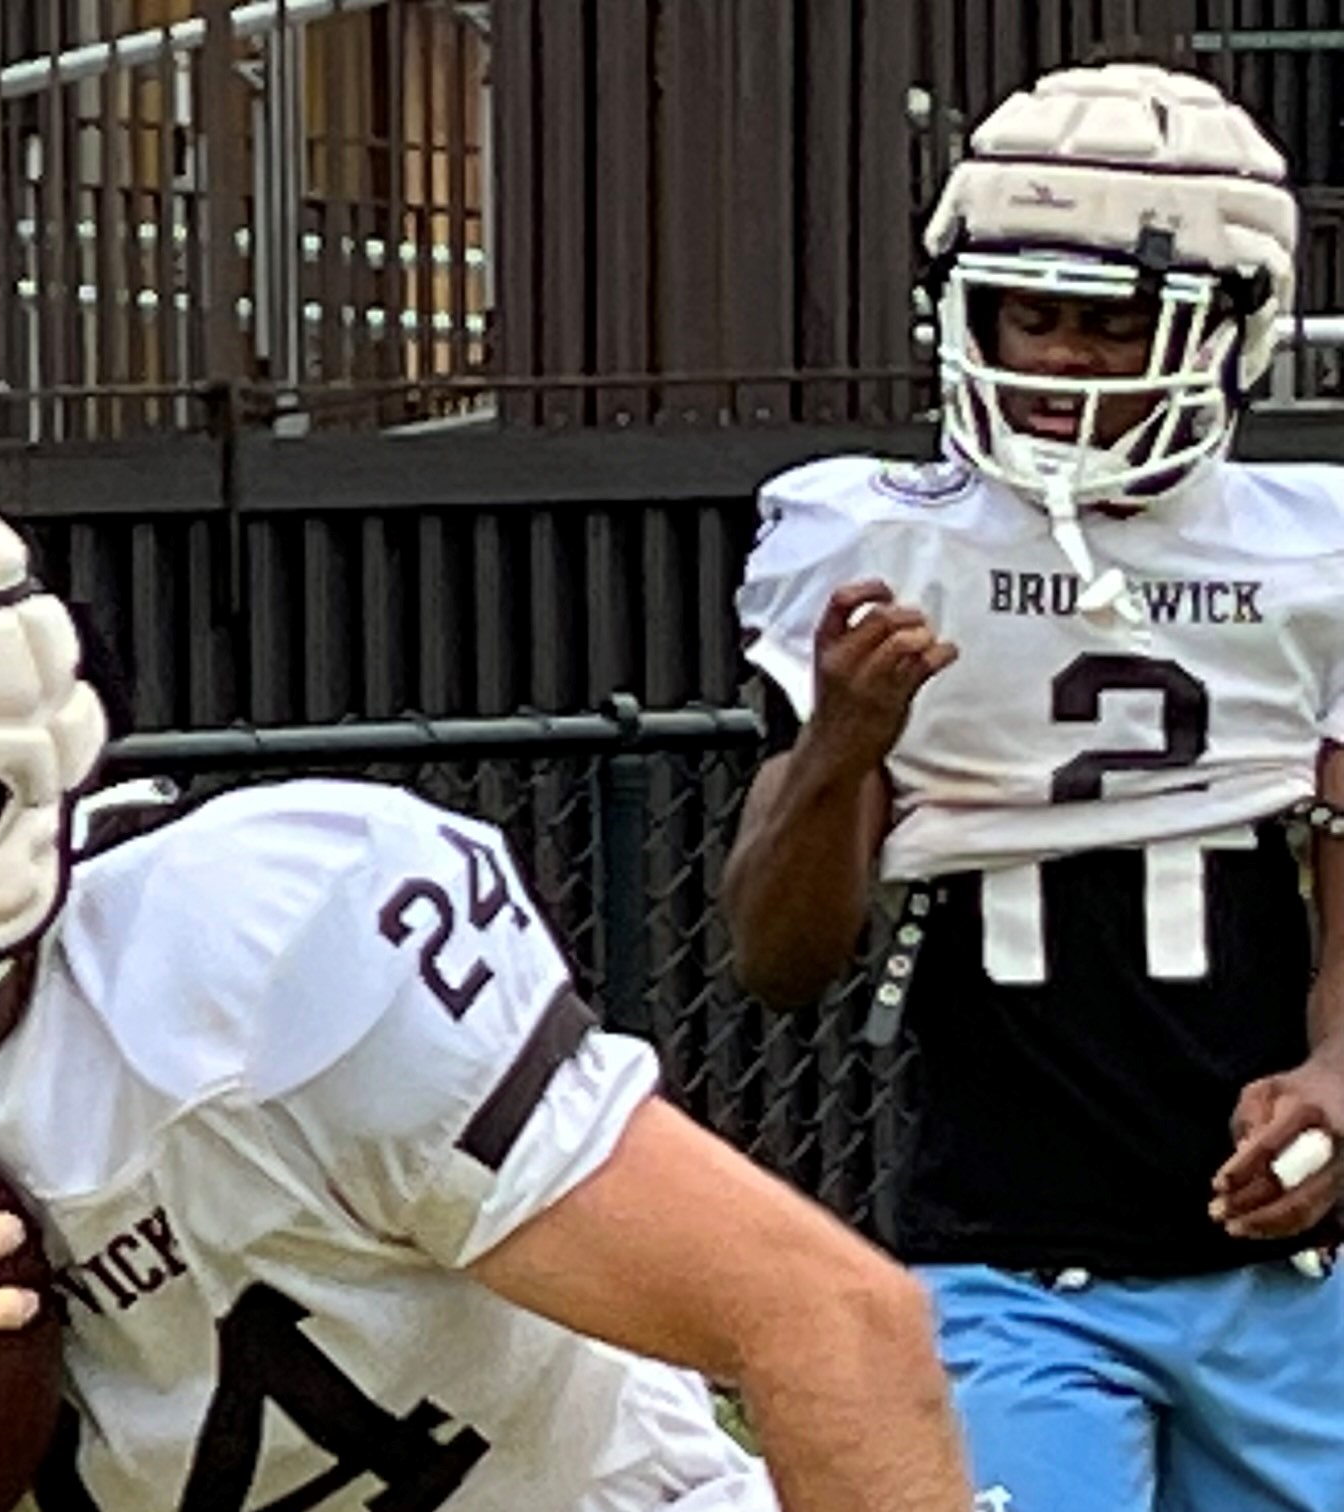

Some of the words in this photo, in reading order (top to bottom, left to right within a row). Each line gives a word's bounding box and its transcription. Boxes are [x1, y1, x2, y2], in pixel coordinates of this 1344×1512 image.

[990, 569, 1264, 624] BRUWICK
[1052, 651, 1210, 803] 2
[378, 824, 531, 1022] 24
